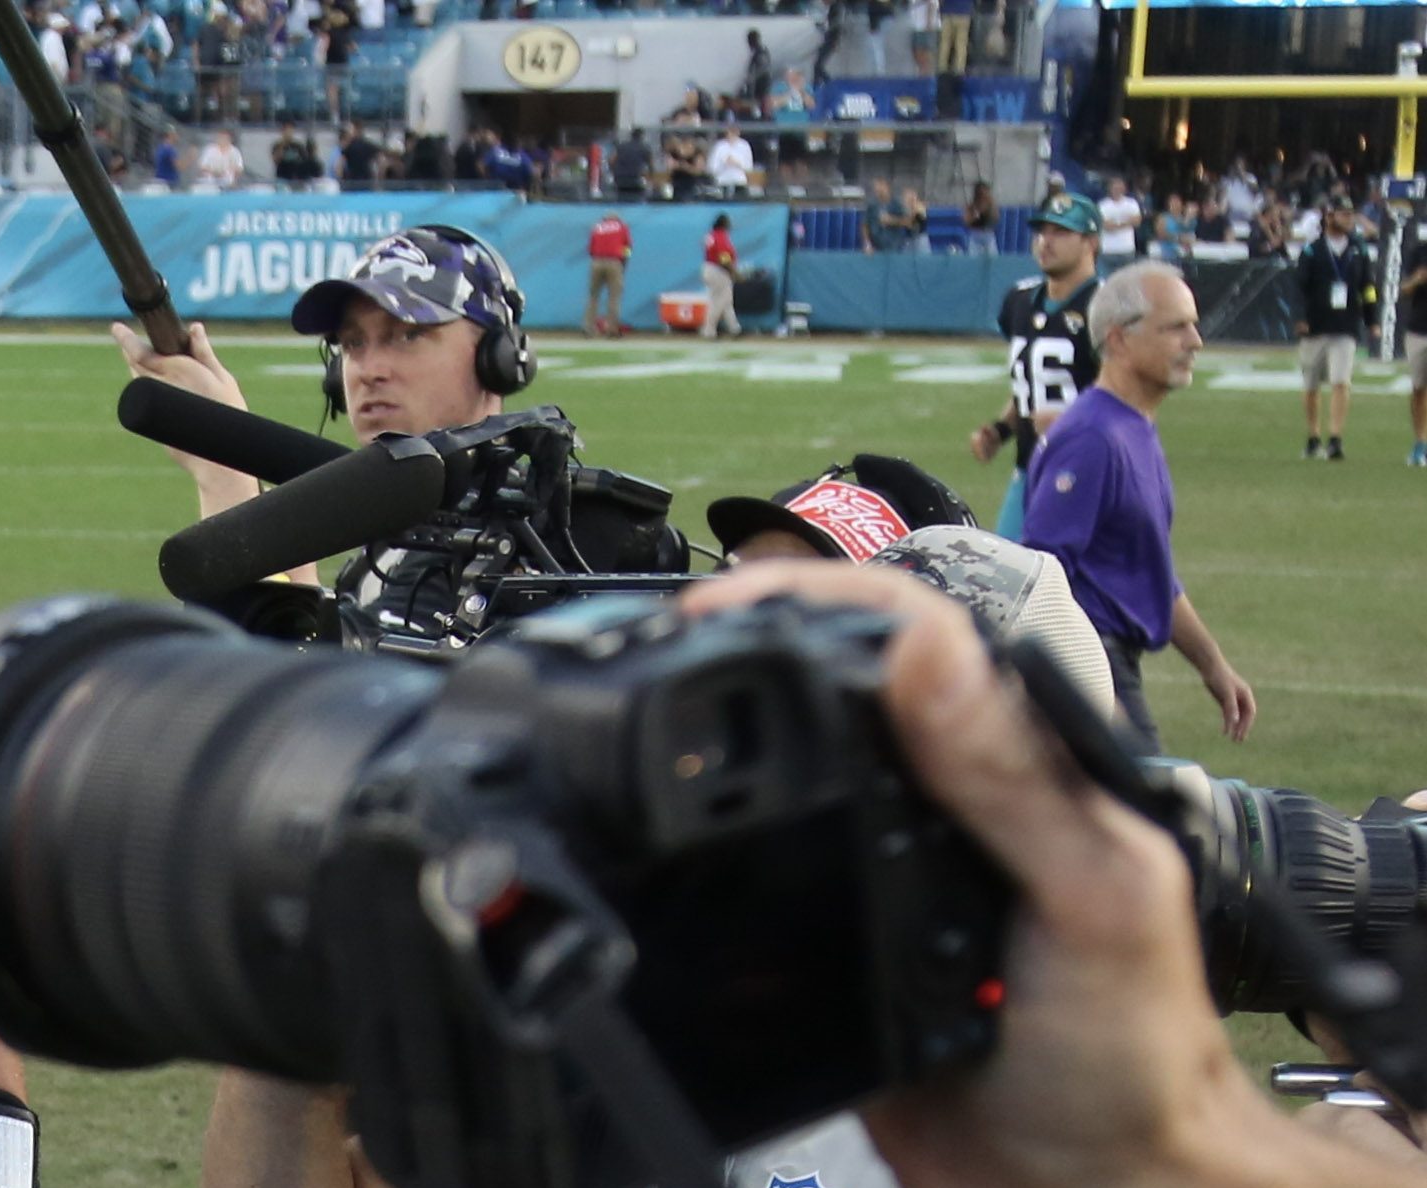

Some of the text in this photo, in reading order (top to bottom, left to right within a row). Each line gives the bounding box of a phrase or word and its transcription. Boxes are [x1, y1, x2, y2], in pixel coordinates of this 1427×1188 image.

[517, 41, 565, 74] 147
[219, 211, 403, 236] JACKSONVILLE
[189, 240, 366, 302] JAGUA
[1010, 336, 1080, 418] 46
